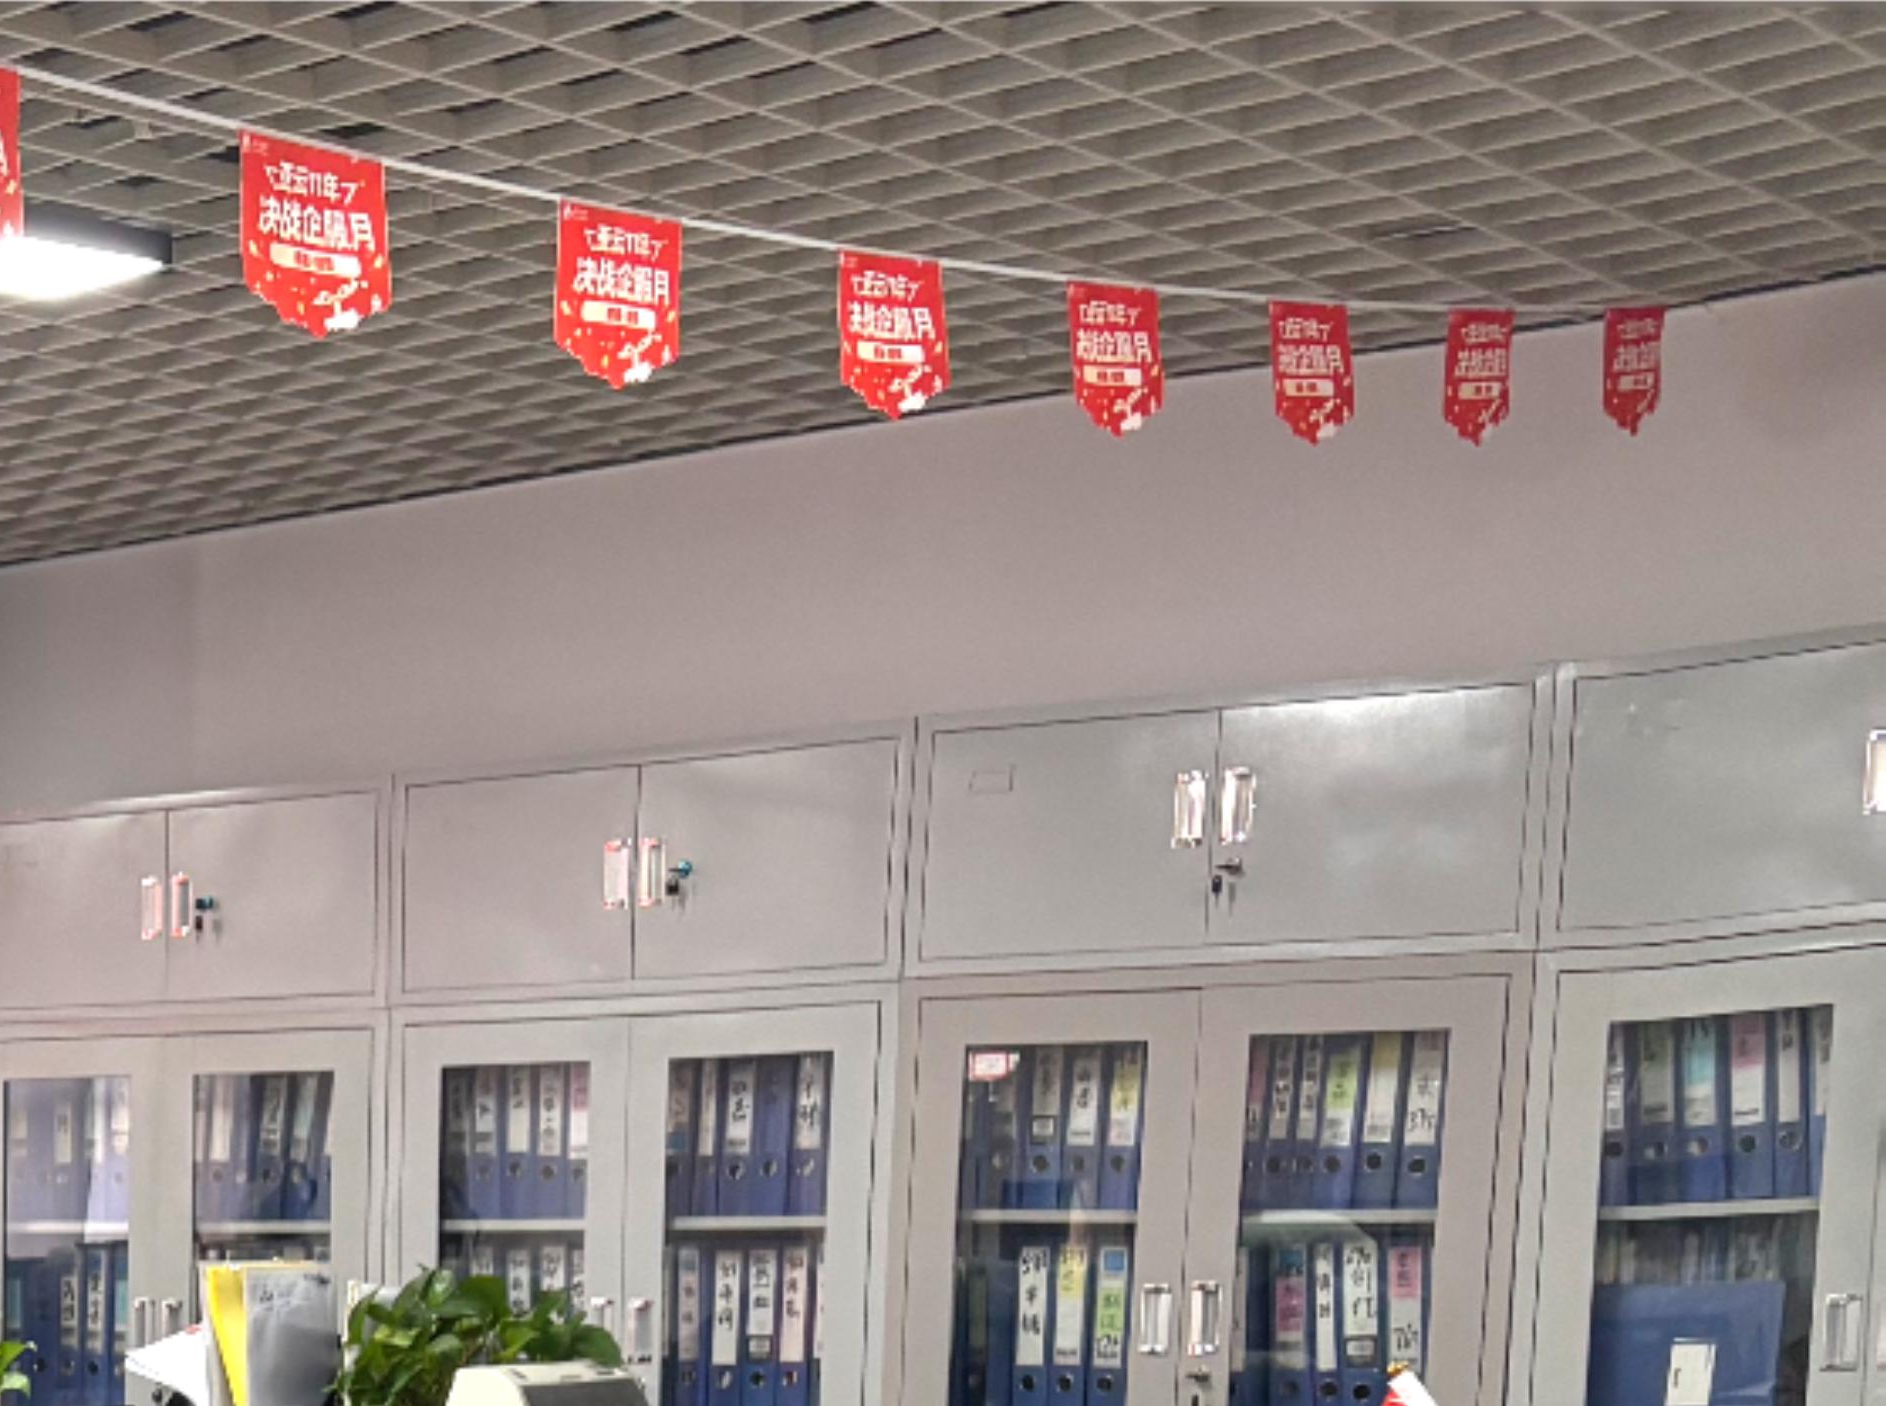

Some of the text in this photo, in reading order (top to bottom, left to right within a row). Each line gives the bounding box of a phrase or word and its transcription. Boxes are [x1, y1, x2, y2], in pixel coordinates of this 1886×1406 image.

[258, 195, 377, 253] 决战企服月
[571, 256, 672, 306] 决战企服月
